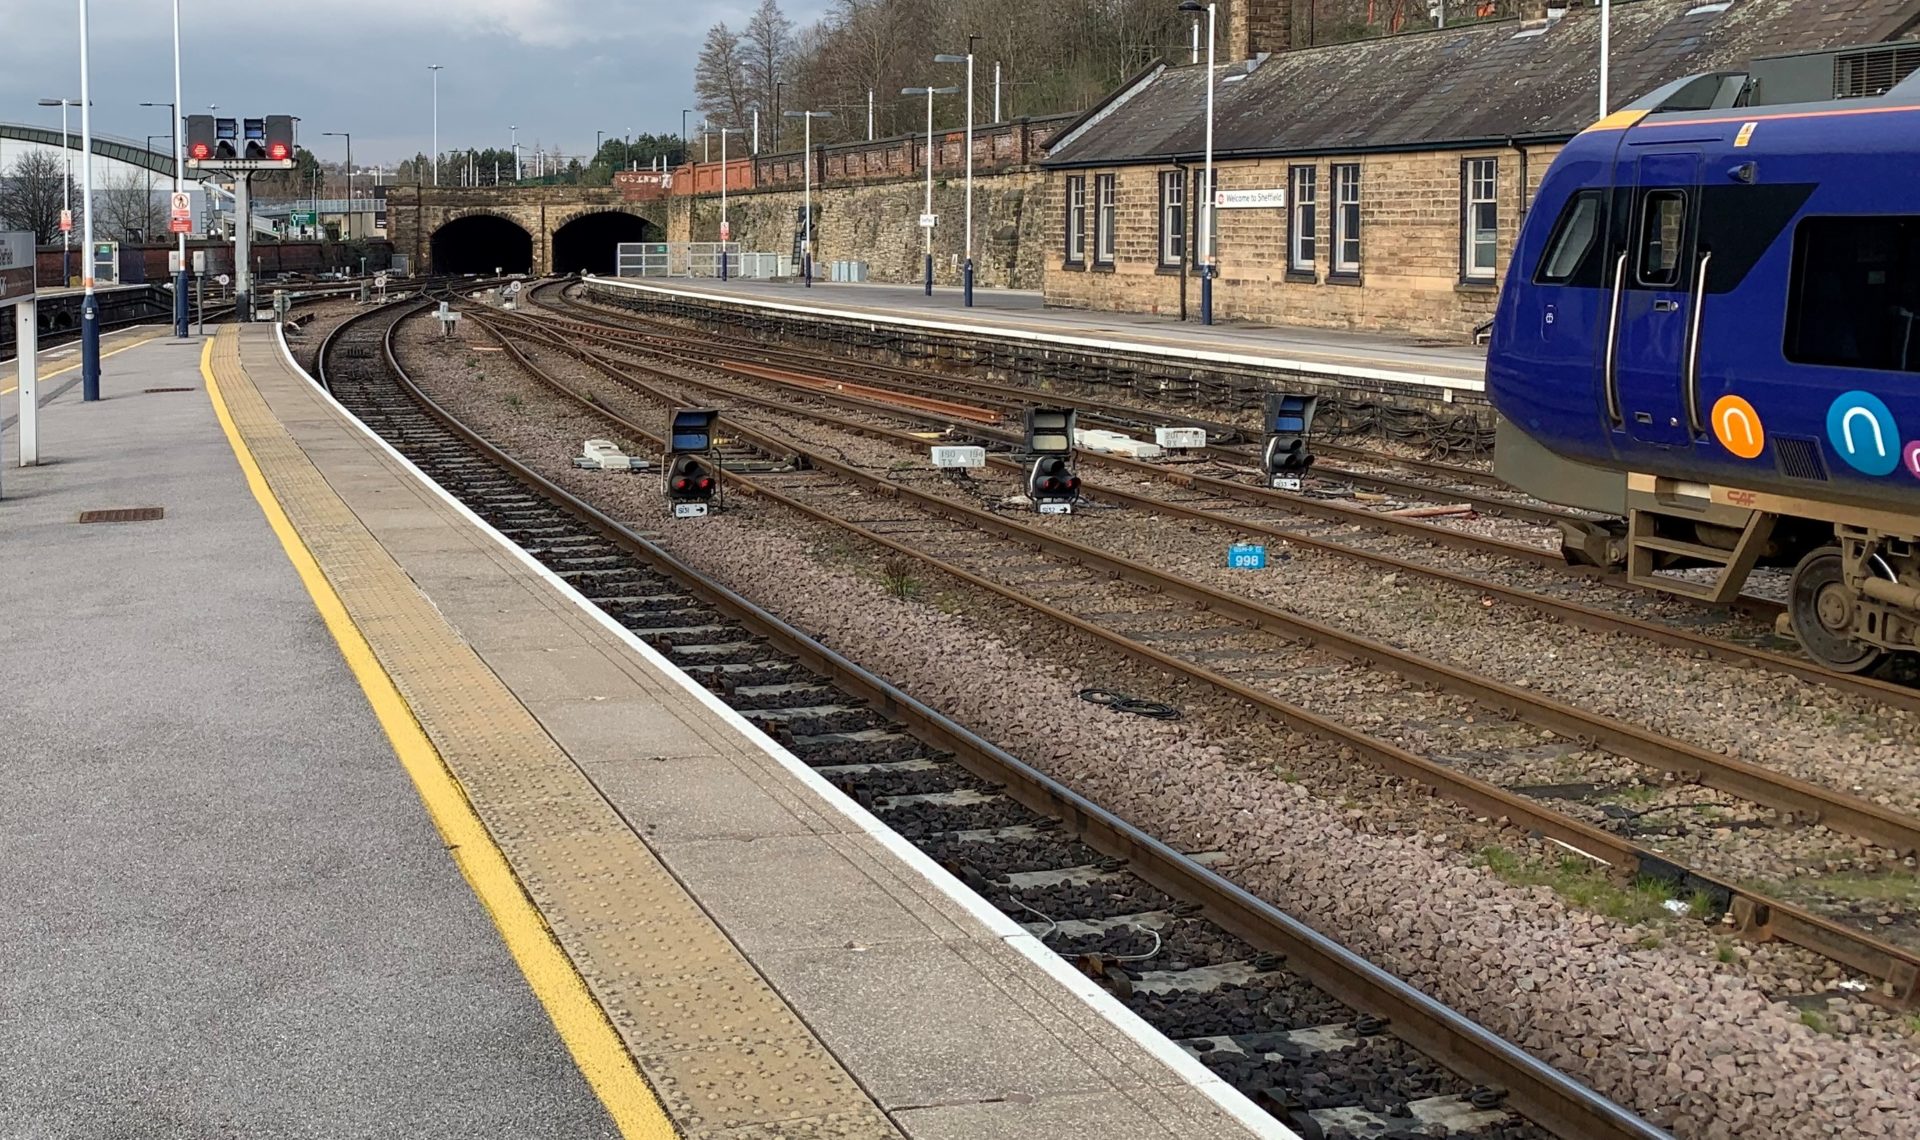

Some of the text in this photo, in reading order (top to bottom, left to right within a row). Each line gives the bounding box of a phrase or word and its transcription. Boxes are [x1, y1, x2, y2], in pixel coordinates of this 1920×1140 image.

[1226, 192, 1282, 202] Welcome to Sheffield
[1727, 490, 1757, 506] CAF
[1236, 555, 1258, 566] 998
